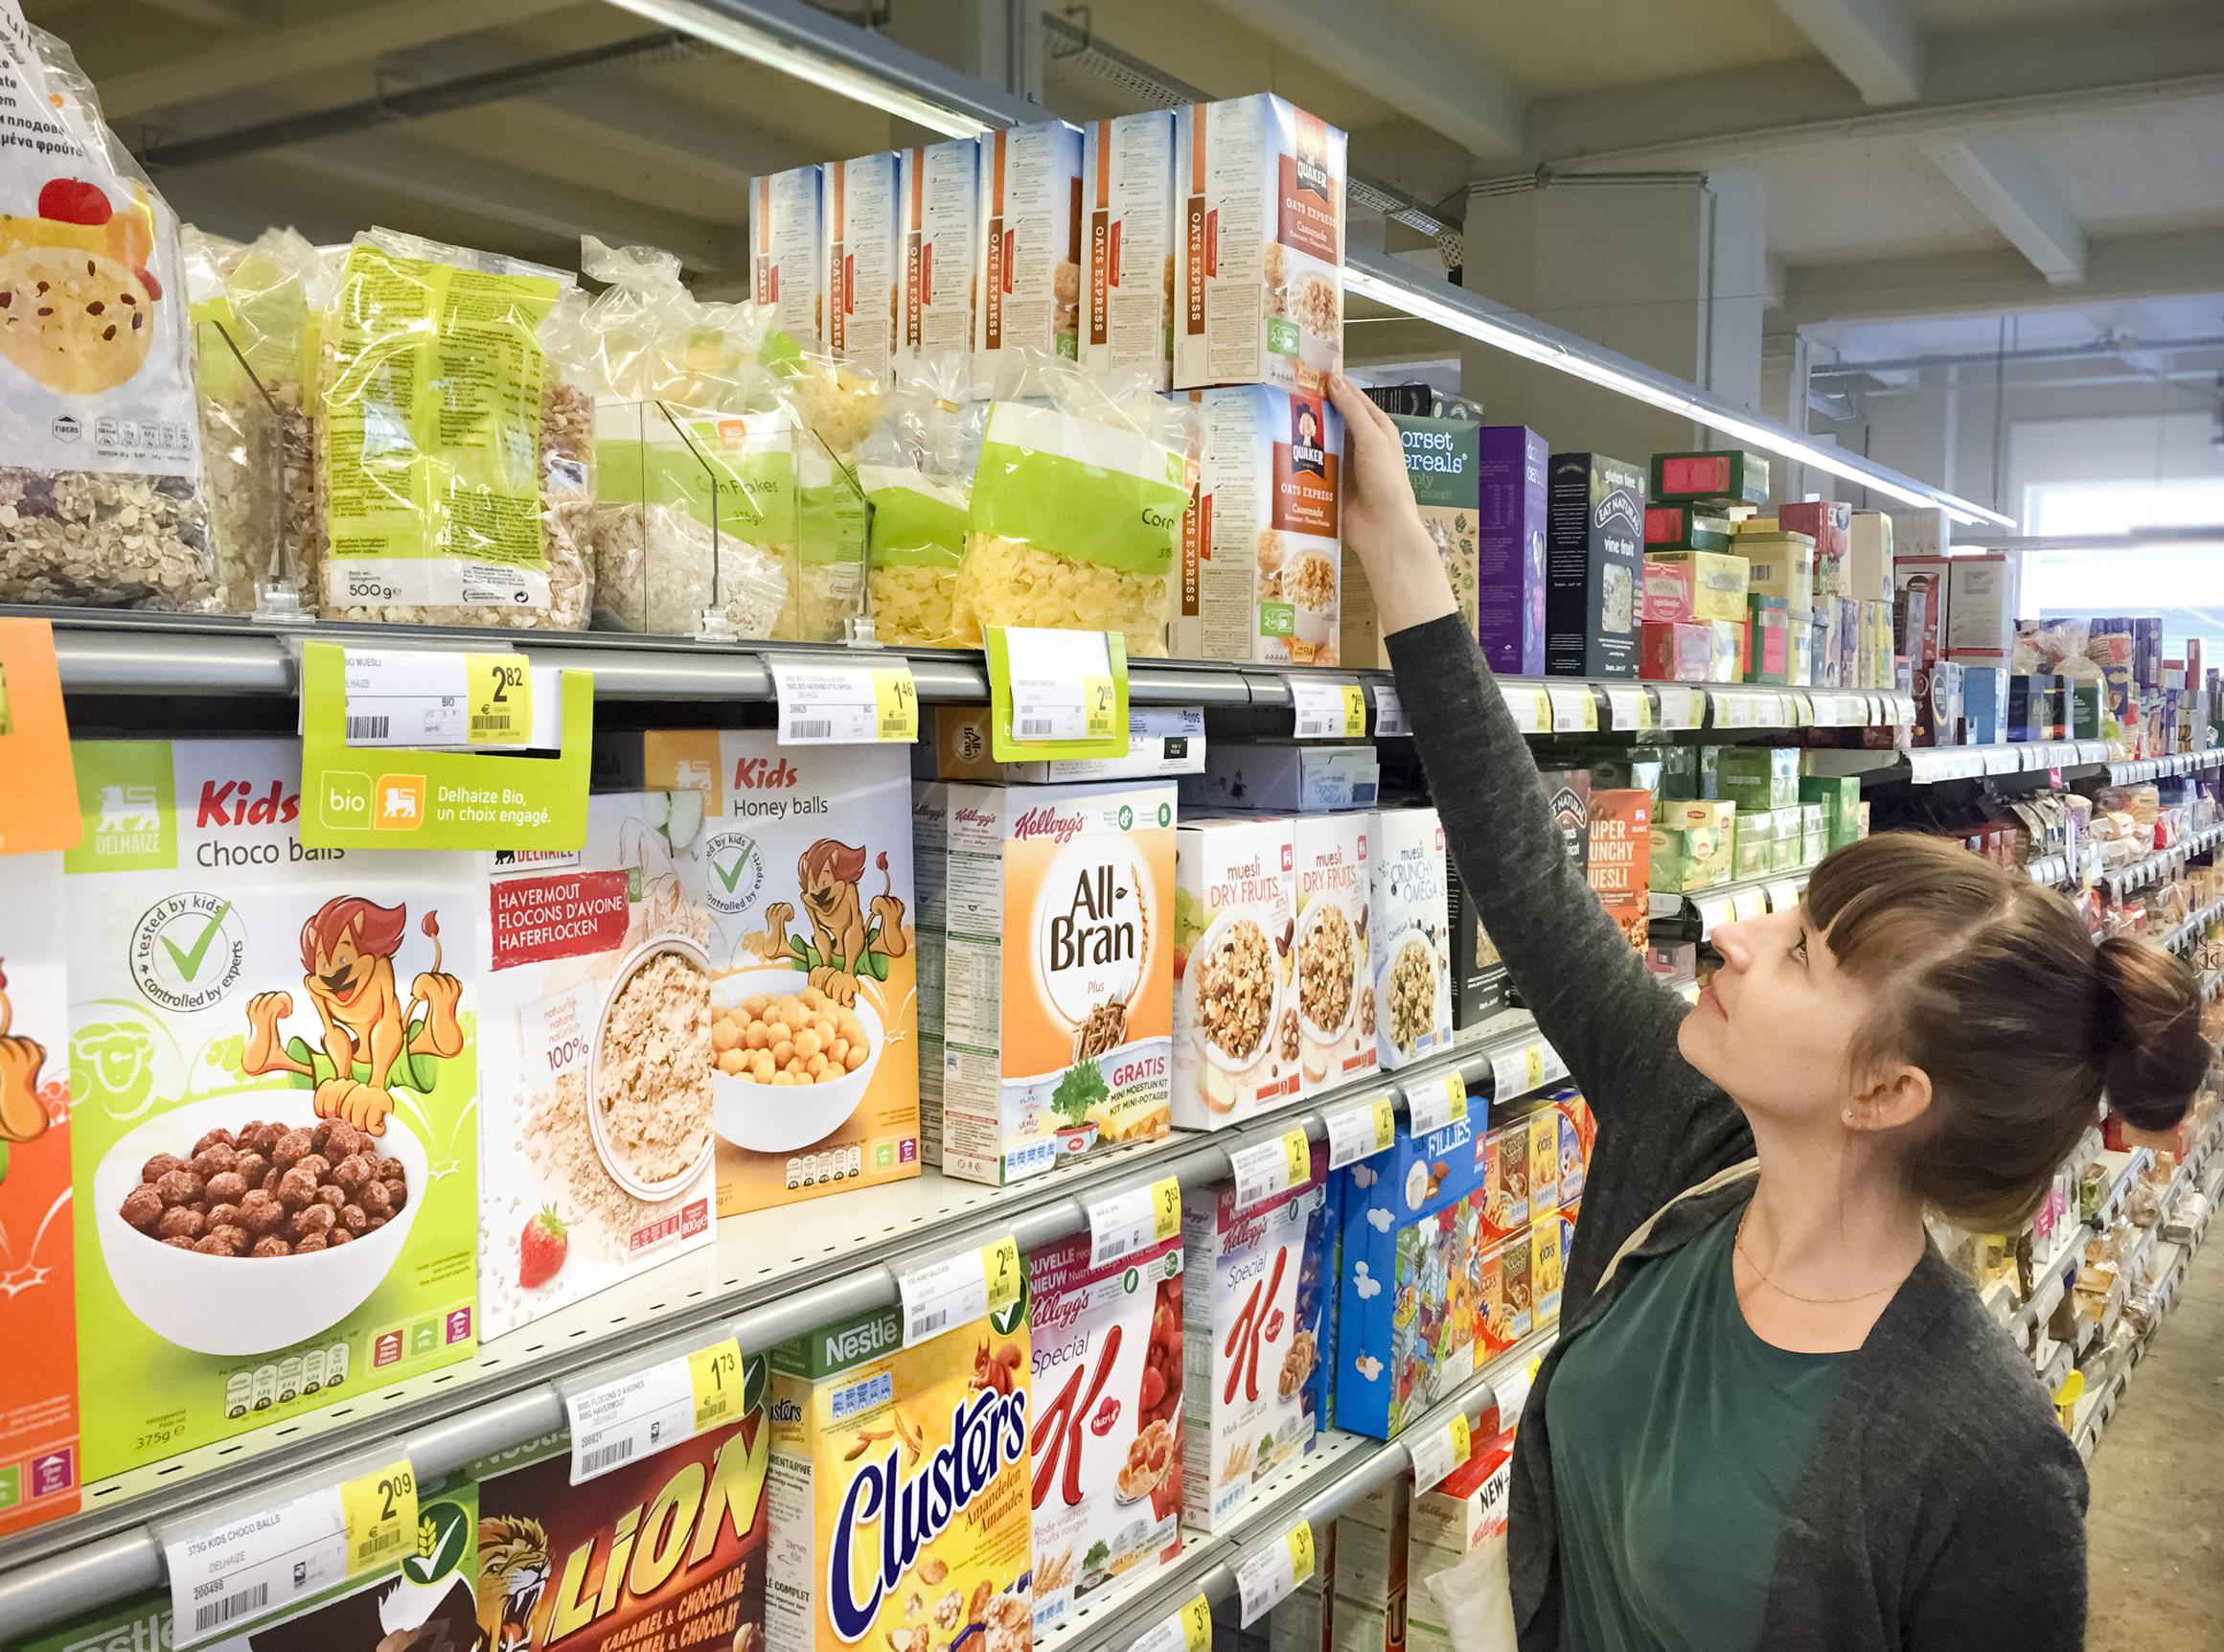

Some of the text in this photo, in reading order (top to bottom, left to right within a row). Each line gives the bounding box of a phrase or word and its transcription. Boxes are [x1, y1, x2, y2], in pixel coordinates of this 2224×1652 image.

[1297, 160, 1327, 189] QUAKER
[1286, 197, 1306, 212] OATS
[833, 258, 841, 293] OATS
[910, 246, 919, 284] OATS
[1094, 225, 1104, 332] OATS EXPRESS
[1191, 212, 1201, 322] OATS EXPRESS
[989, 233, 998, 337] OATS EXPRESS
[55, 425, 79, 434] FIBERS
[1399, 430, 1454, 451] orset
[1293, 445, 1324, 466] QUAKER
[1405, 452, 1462, 474] ereals
[730, 478, 779, 495] Flakes
[1410, 472, 1434, 489] ply
[1605, 469, 1623, 486] gluten
[1280, 482, 1334, 502] OATS EXPRESS
[1142, 508, 1175, 530] Corn
[1598, 497, 1641, 532] EAT NATURAL
[1186, 497, 1196, 604] OATS EXPRESS
[1604, 537, 1635, 558] vine fruit
[356, 658, 382, 667] MUESLI
[346, 679, 371, 688] LHAIZE
[442, 698, 455, 707] BIO
[964, 726, 974, 757] Bran
[734, 757, 798, 790] Kids
[196, 780, 301, 828] Kids
[330, 789, 365, 812] bio
[438, 787, 527, 808] Delhaize Bio,
[734, 795, 828, 820] Honey balls
[1557, 794, 1587, 823] NATURAL
[437, 807, 552, 827] un choix engagé.
[954, 808, 997, 828] Kellogg's
[1015, 807, 1086, 844] Kellogg's
[1590, 819, 1626, 841] UPER
[96, 833, 160, 856] DELHAIZE
[196, 840, 280, 867] Choco
[715, 834, 746, 849] by kids
[1316, 843, 1343, 868] muesli
[1400, 839, 1425, 862] muesli
[1589, 841, 1635, 862] UNCHY
[746, 890, 757, 904] by
[753, 852, 765, 890] experts
[1227, 853, 1261, 881] muesli
[1303, 865, 1358, 893] DRY FRUITS
[1390, 862, 1433, 883] CRUNCHY
[498, 883, 581, 910] HAVERMOUT
[1210, 876, 1279, 909] DRY FRUITS
[1403, 882, 1439, 904] OMEGA
[498, 895, 623, 929] FLOCONS D'AVOINE
[137, 895, 223, 958] tested by kids
[499, 918, 598, 952] HAFERFLOCKEN
[1050, 915, 1135, 973] Bran
[143, 940, 243, 1008] controlled by experts
[1088, 979, 1105, 995] Plus
[546, 1035, 589, 1072] 100%
[1112, 1056, 1165, 1088] GRATIS
[1110, 1090, 1168, 1116] KIT MINI-POTAGER
[1111, 1078, 1168, 1103] MINI MOESTUIN KIT
[1428, 1117, 1472, 1160] FILLIES
[1223, 1216, 1268, 1255] Kellogg's
[1029, 1270, 1067, 1294] NIEUW
[1228, 1250, 1268, 1292] Special
[825, 1313, 898, 1367] Nestlé
[1224, 1246, 1288, 1406] K
[1031, 1330, 1090, 1380] Special
[591, 1390, 617, 1406] FLOCONS
[622, 1380, 646, 1394] AVOINES
[593, 1396, 626, 1415] HAVERMOUT
[1030, 1324, 1122, 1511] K
[135, 1429, 172, 1450] 375g
[964, 1468, 1022, 1532] Amandelen
[1479, 1470, 1504, 1514] NEW
[830, 1388, 1026, 1638] Clusters
[978, 1488, 1025, 1538] Amandes
[1034, 1504, 1091, 1538] Rode vruchten
[188, 1513, 282, 1557] 375G KIDS CHOCO BALLS
[1036, 1519, 1089, 1549] Fruits rouges
[209, 1550, 246, 1574] DELHAIZE
[194, 1579, 225, 1601] 200498
[774, 1580, 811, 1603] COMPLET
[599, 1563, 747, 1652] KARAMEL & CHOCOLADE
[63, 1609, 174, 1652] stlé
[668, 1600, 741, 1650] & CHOCOLAT
